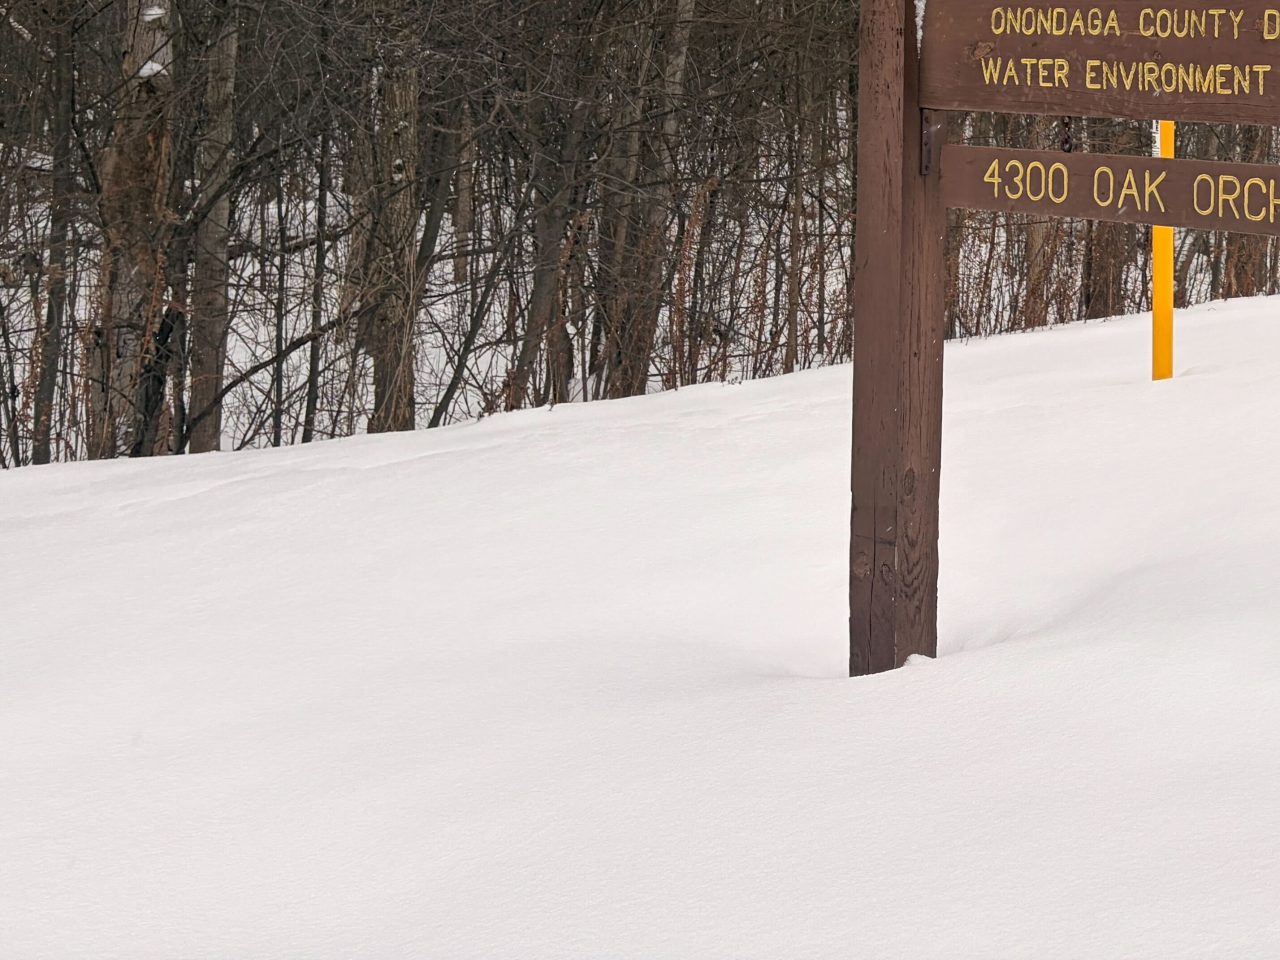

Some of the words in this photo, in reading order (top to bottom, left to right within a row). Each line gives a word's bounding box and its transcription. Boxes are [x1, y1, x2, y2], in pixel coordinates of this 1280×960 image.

[989, 5, 1122, 38] ONONDAGA
[1135, 6, 1246, 40] COUNTY
[978, 53, 1071, 90] WATER
[1084, 59, 1273, 97] ENVIRONMENT
[982, 157, 1070, 205] 4300
[1092, 164, 1168, 214] OAK
